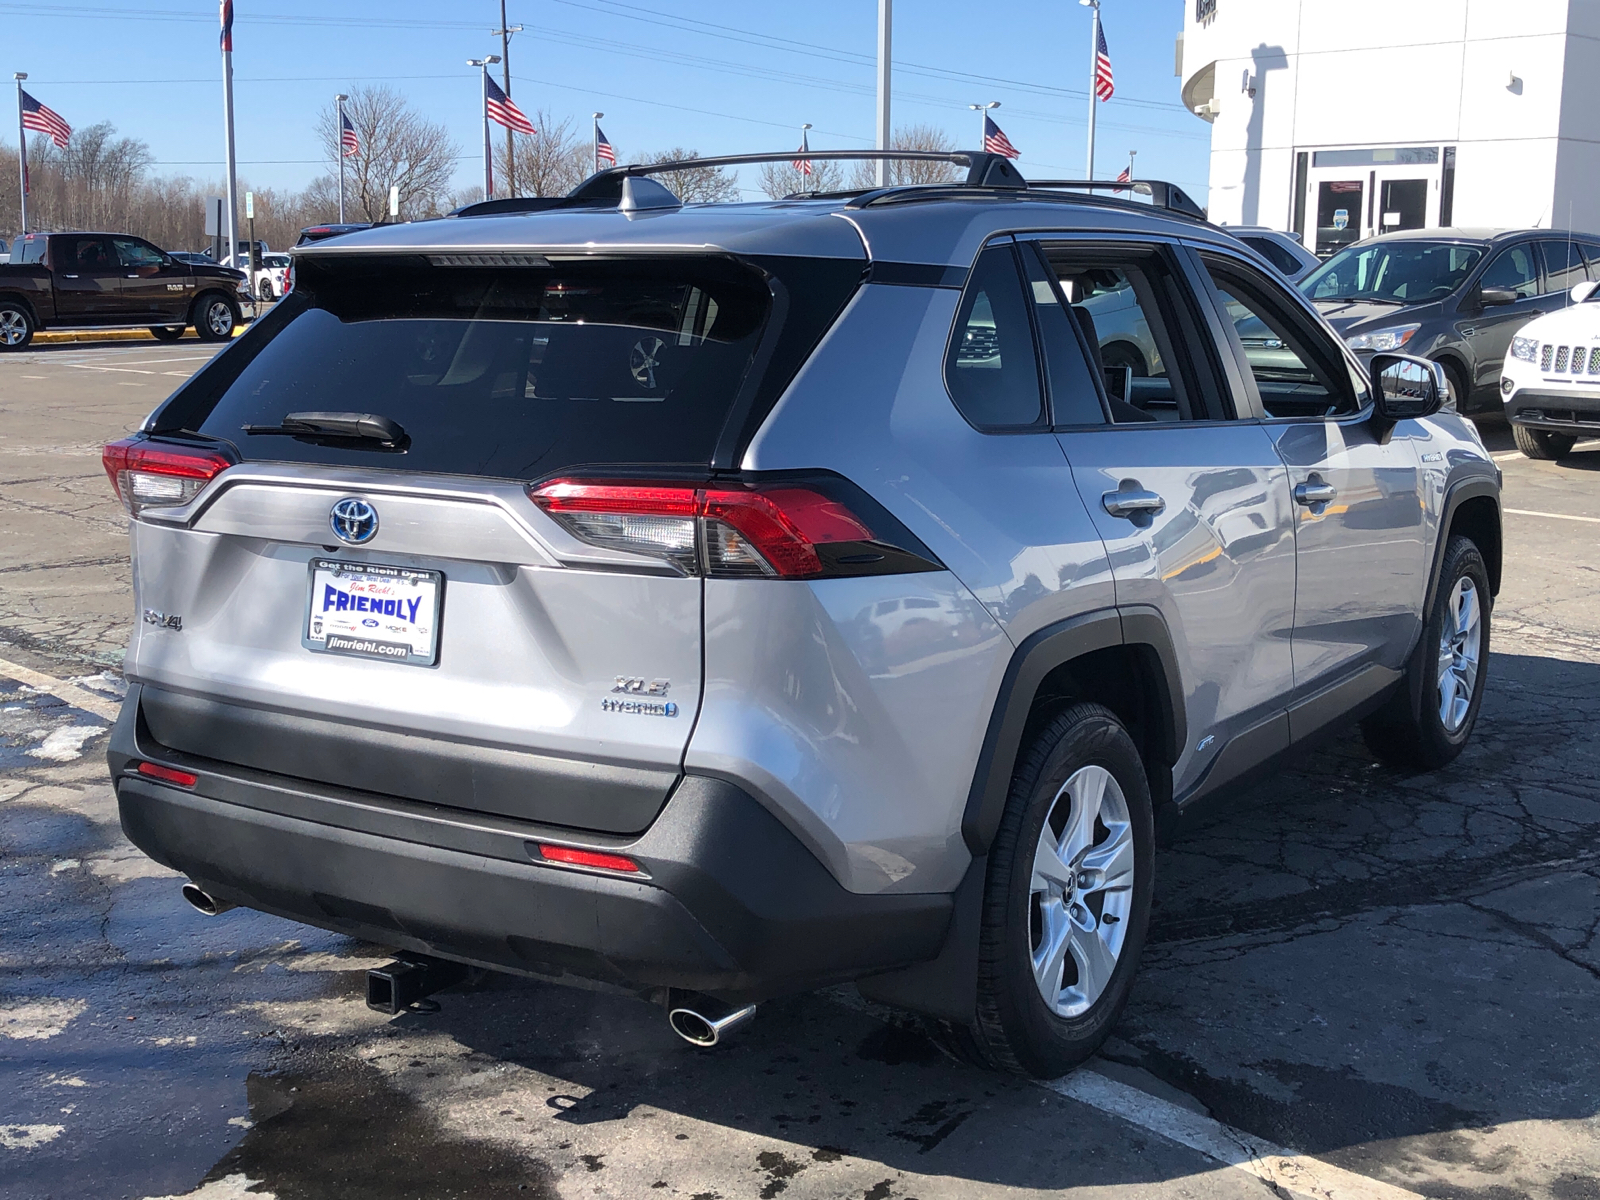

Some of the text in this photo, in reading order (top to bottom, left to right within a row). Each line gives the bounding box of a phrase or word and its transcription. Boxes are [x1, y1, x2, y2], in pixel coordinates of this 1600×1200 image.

[319, 561, 341, 570] Get
[344, 564, 364, 572] the
[366, 566, 398, 576] Riehl
[348, 582, 365, 593] Jim
[323, 583, 423, 624] FRIENDLY
[328, 637, 407, 656] jimriehl.com
[611, 676, 671, 698] XLE
[601, 697, 665, 717] HYBRID
